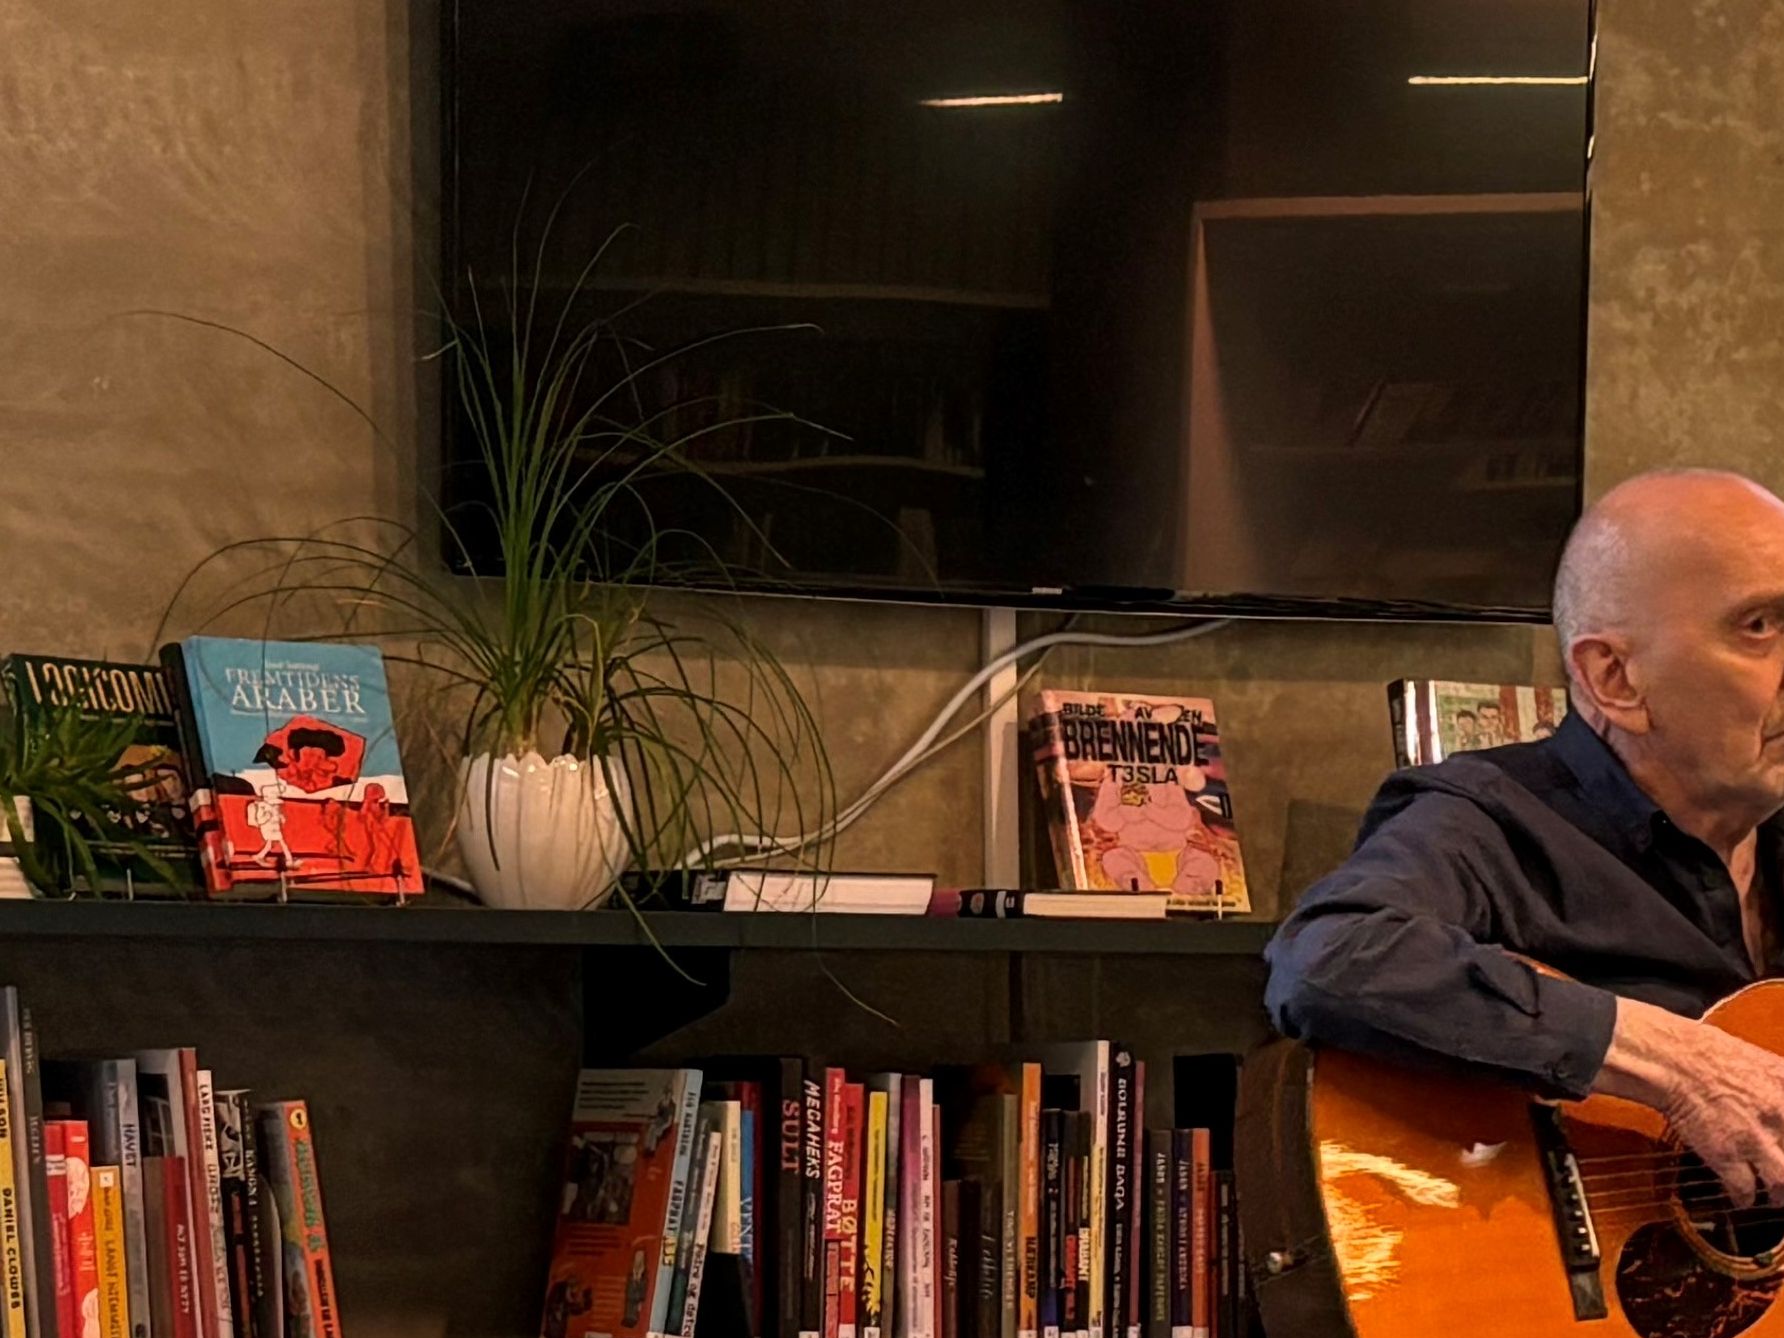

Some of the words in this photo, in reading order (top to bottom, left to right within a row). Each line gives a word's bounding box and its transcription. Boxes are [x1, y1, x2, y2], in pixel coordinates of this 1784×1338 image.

[232, 684, 366, 713] ARABER
[1062, 703, 1106, 718] BILDE
[1135, 706, 1153, 719] AV
[1063, 719, 1210, 766] BRENNENDE
[1107, 764, 1179, 785] T3SLA
[123, 1123, 137, 1168] HAVET
[782, 1099, 799, 1174] SULT
[804, 1079, 821, 1179] MEGAHEKS
[825, 1141, 845, 1234] FAGPRAT
[3, 1188, 15, 1243] DANIEL
[840, 1198, 858, 1292] BØTTE
[7, 1247, 19, 1309] CLOWES
